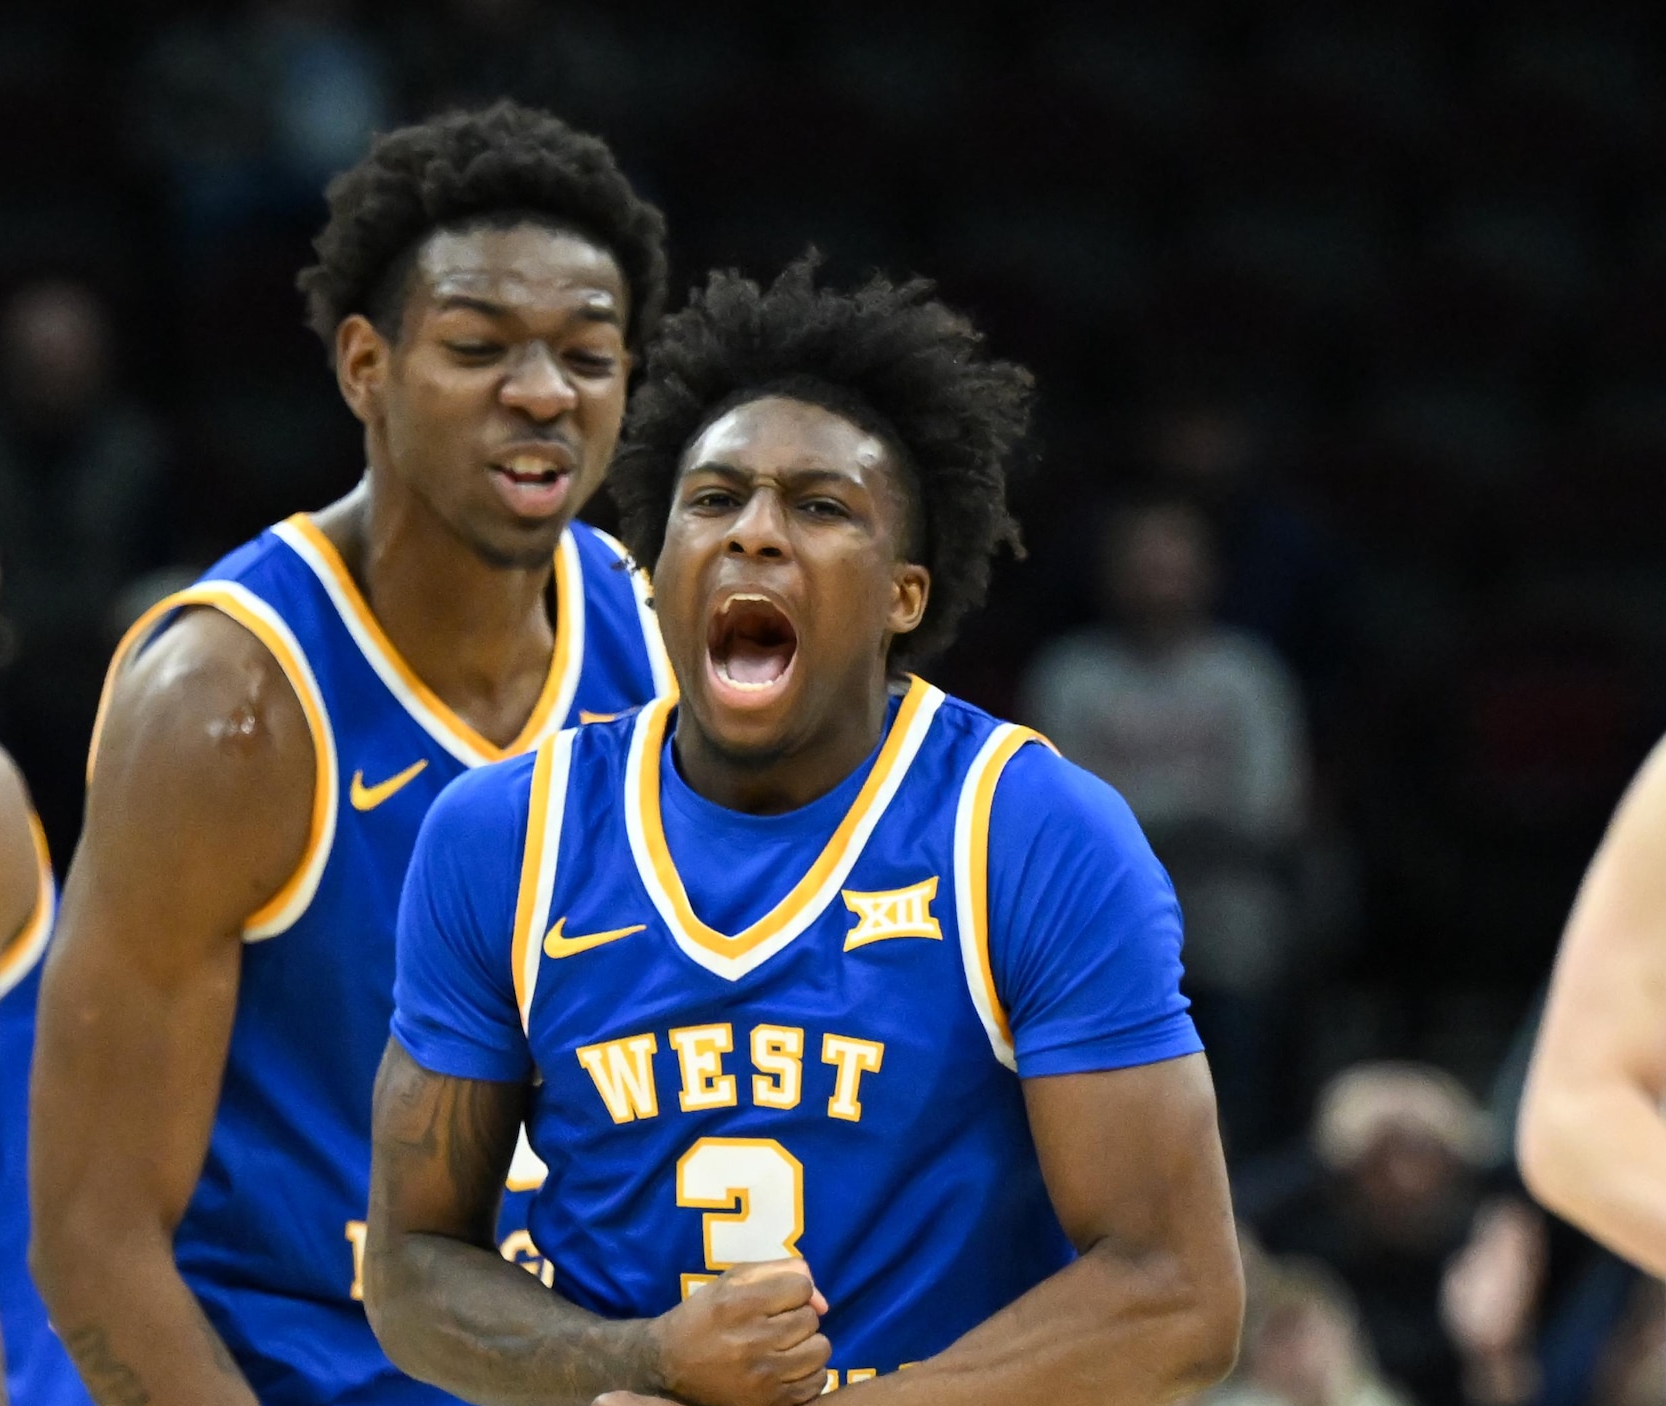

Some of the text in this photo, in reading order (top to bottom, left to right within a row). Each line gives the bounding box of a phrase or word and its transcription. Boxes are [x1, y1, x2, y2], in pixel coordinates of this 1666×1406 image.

[841, 876, 943, 952] XII
[576, 1022, 885, 1125] WEST
[676, 1136, 805, 1301] 3
